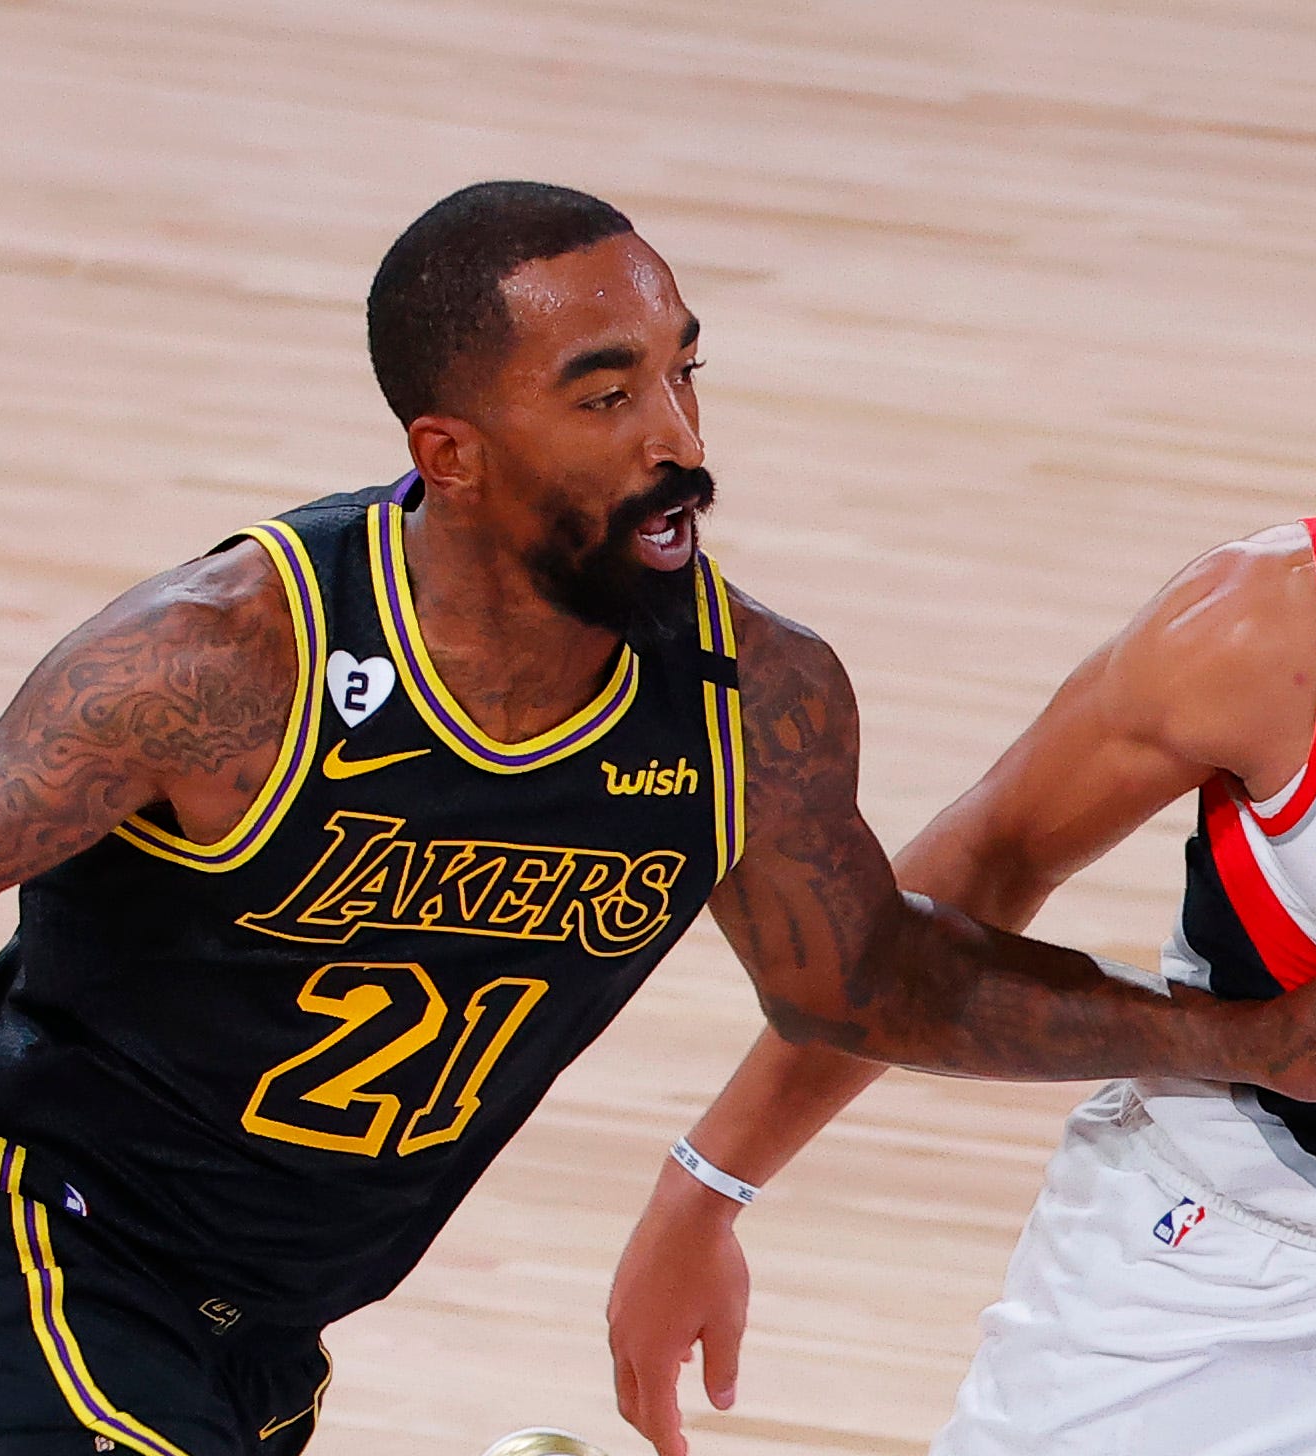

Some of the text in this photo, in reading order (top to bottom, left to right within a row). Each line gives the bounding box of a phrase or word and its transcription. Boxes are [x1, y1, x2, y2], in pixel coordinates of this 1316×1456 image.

[344, 671, 369, 711] 2
[600, 757, 698, 796] wish
[235, 810, 686, 957] LAKERS
[240, 962, 549, 1158] 21
